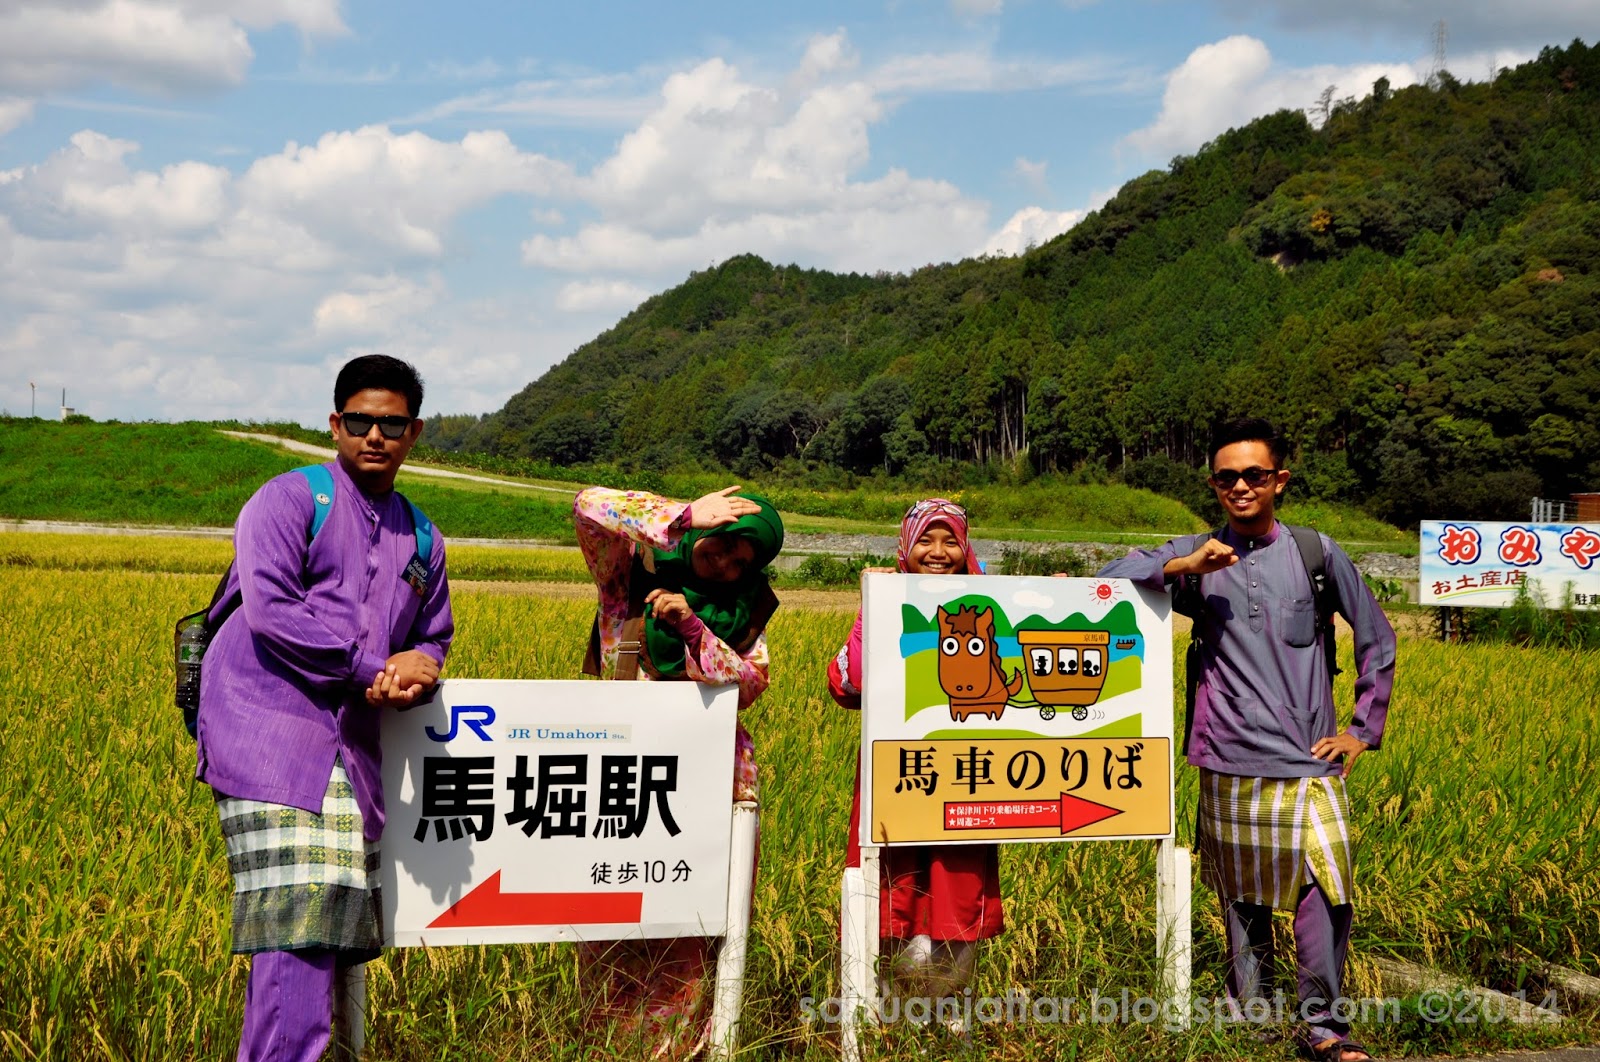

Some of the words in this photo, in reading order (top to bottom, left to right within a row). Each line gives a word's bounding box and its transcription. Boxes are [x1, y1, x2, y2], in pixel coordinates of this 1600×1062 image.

[1438, 524, 1600, 570] おみや
[1431, 569, 1527, 595] お土産店
[424, 705, 497, 742] JR
[507, 728, 531, 739] JR
[536, 728, 608, 739] Umahori
[894, 742, 1145, 796] 馬車のりば
[413, 754, 682, 843] 馬堀駅
[590, 859, 693, 885] 徒歩10分
